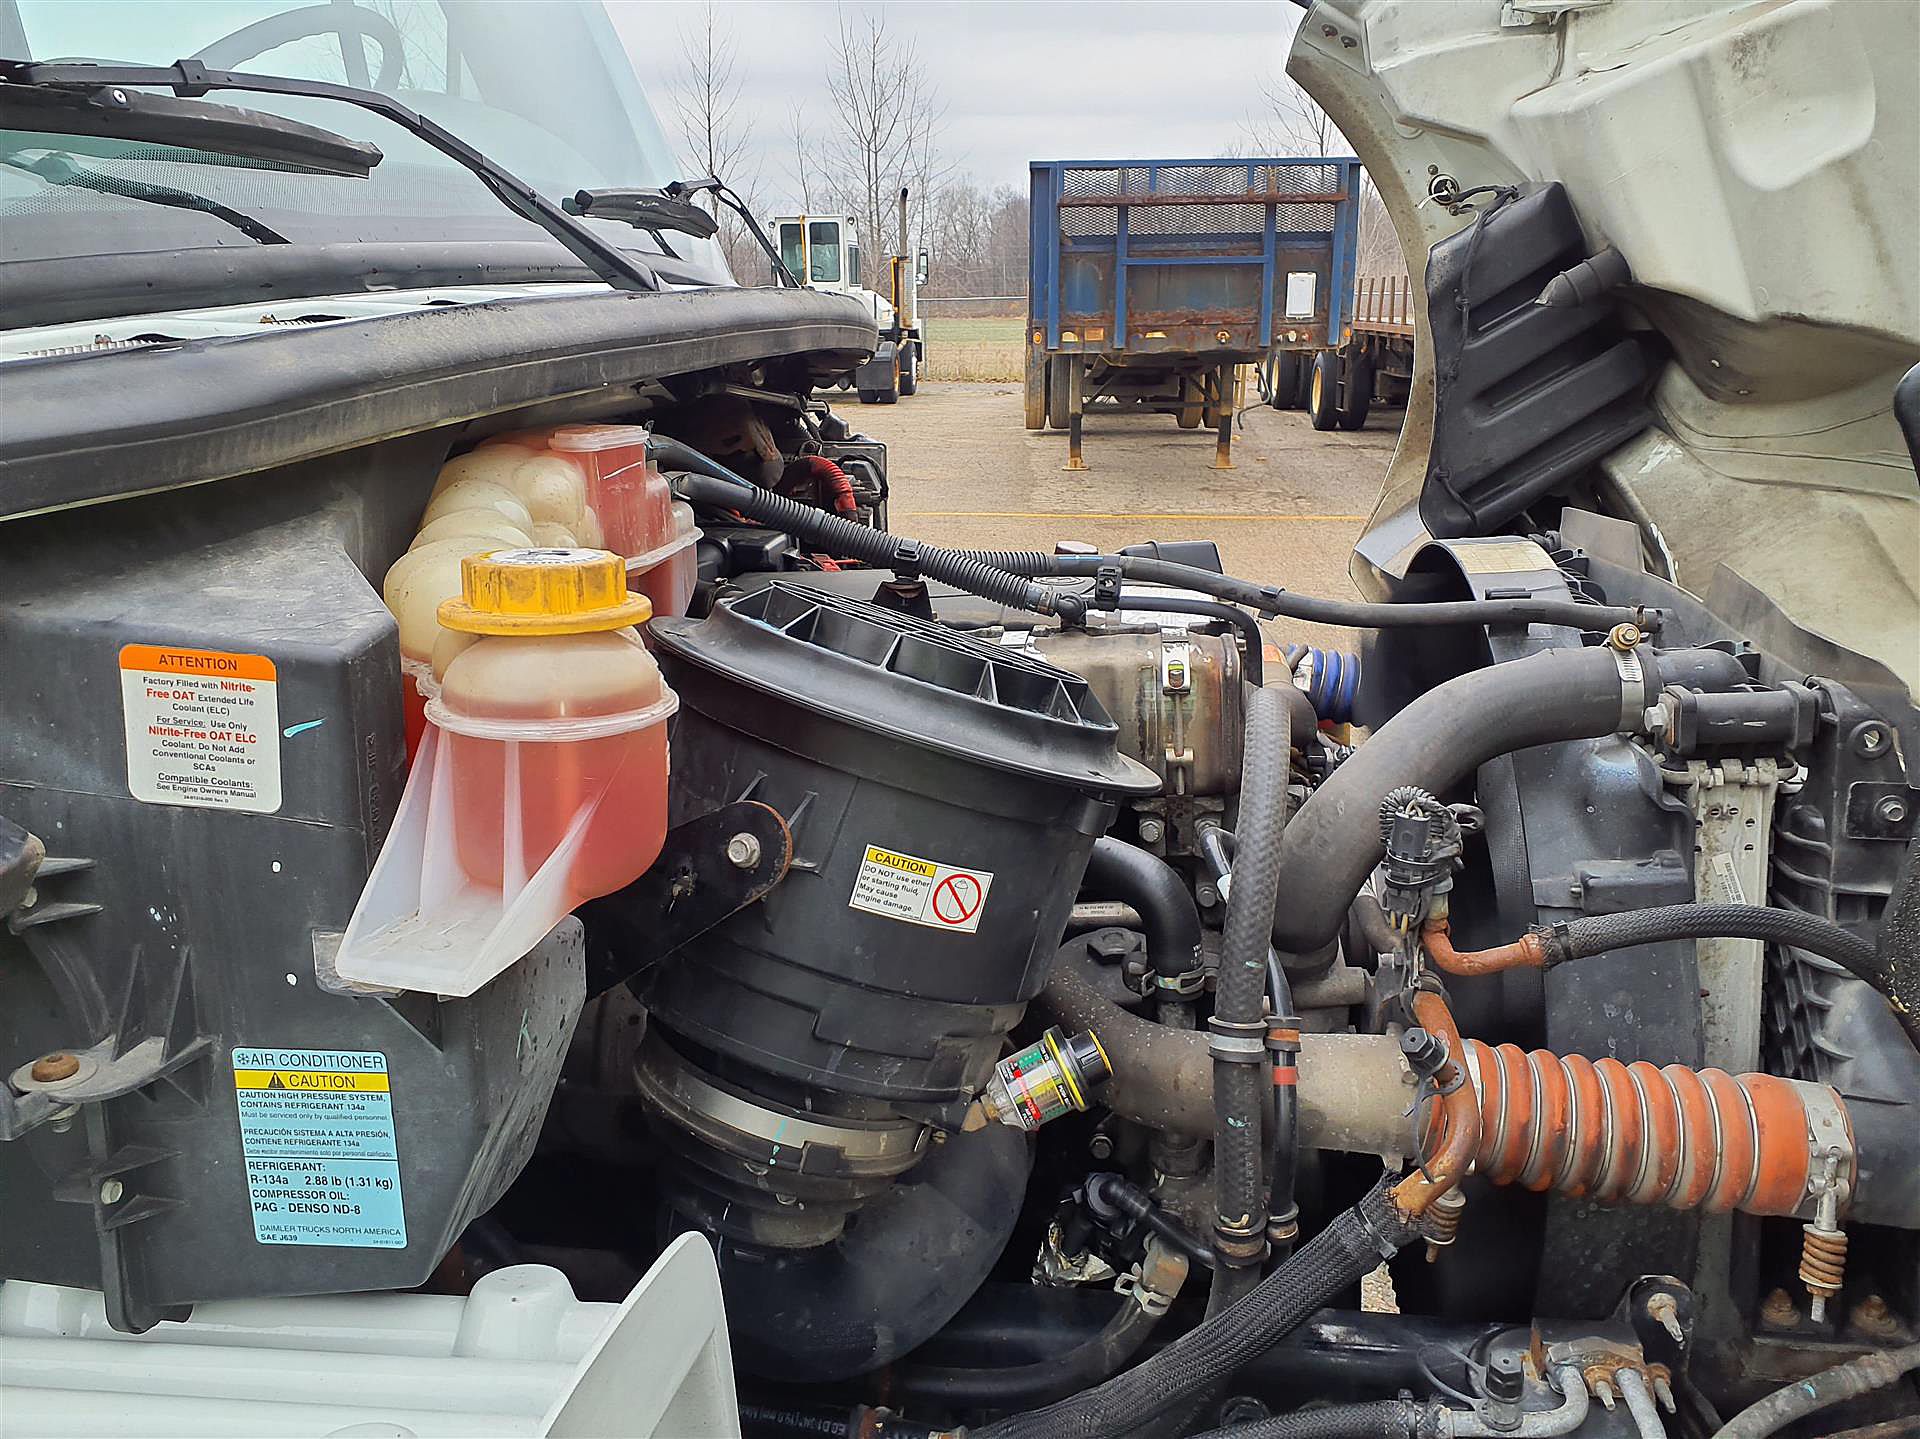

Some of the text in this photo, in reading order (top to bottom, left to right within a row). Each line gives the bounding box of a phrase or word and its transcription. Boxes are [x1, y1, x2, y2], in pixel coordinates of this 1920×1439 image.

[159, 654, 237, 671] ATTENTION
[143, 677, 256, 692] Factory Filled with Nitrite-
[146, 688, 254, 706] Free OAT Extended Life
[173, 703, 230, 716] Coolant (ELC)
[157, 716, 170, 725] For
[228, 721, 247, 730] Only
[149, 726, 257, 744] Nitrite-Free OAT ELC
[162, 740, 196, 750] Coolant.
[212, 744, 227, 752] Not
[229, 745, 245, 754] Add
[153, 749, 206, 761] Conventional
[209, 754, 245, 764] Coolants
[193, 763, 216, 772] SCAs
[158, 773, 253, 788] Compatible Coolants:
[157, 783, 257, 798] See Engine Owners Manual
[876, 853, 928, 874] CAUTION
[865, 865, 876, 873] DO
[878, 869, 895, 878] NOT
[911, 879, 930, 888] ether
[872, 877, 900, 890] starting
[857, 893, 881, 902] engine
[860, 883, 898, 899] May cause
[251, 1053, 384, 1069] AIR CONDITIONER
[289, 1074, 356, 1089] CAUTION
[301, 1093, 347, 1101] PRESSURE
[240, 1101, 283, 1109] CONTAINS
[285, 1102, 344, 1111] REFRIGERANT
[269, 1112, 298, 1120] serviced
[299, 1113, 313, 1121] only
[315, 1113, 323, 1121] by
[325, 1113, 353, 1121] qualified
[244, 1128, 292, 1136] PRECAUCIÓN
[294, 1129, 326, 1137] SISTEMA
[336, 1130, 354, 1138] ALTA
[284, 1139, 342, 1147] REFRIGERANTE
[249, 1162, 326, 1172] REFRIGERANT:
[250, 1175, 393, 1190] R-134a 2.88 lb (1.31 kg)
[252, 1190, 350, 1200] COMPRESSOR OIL:
[254, 1202, 278, 1212] PAG
[288, 1203, 330, 1214] DENSO
[334, 1204, 361, 1215] ND-8
[297, 1225, 331, 1233] TRUCKS
[333, 1227, 361, 1235] NORTH
[364, 1228, 401, 1236] AMERICA
[280, 1234, 298, 1242] J639
